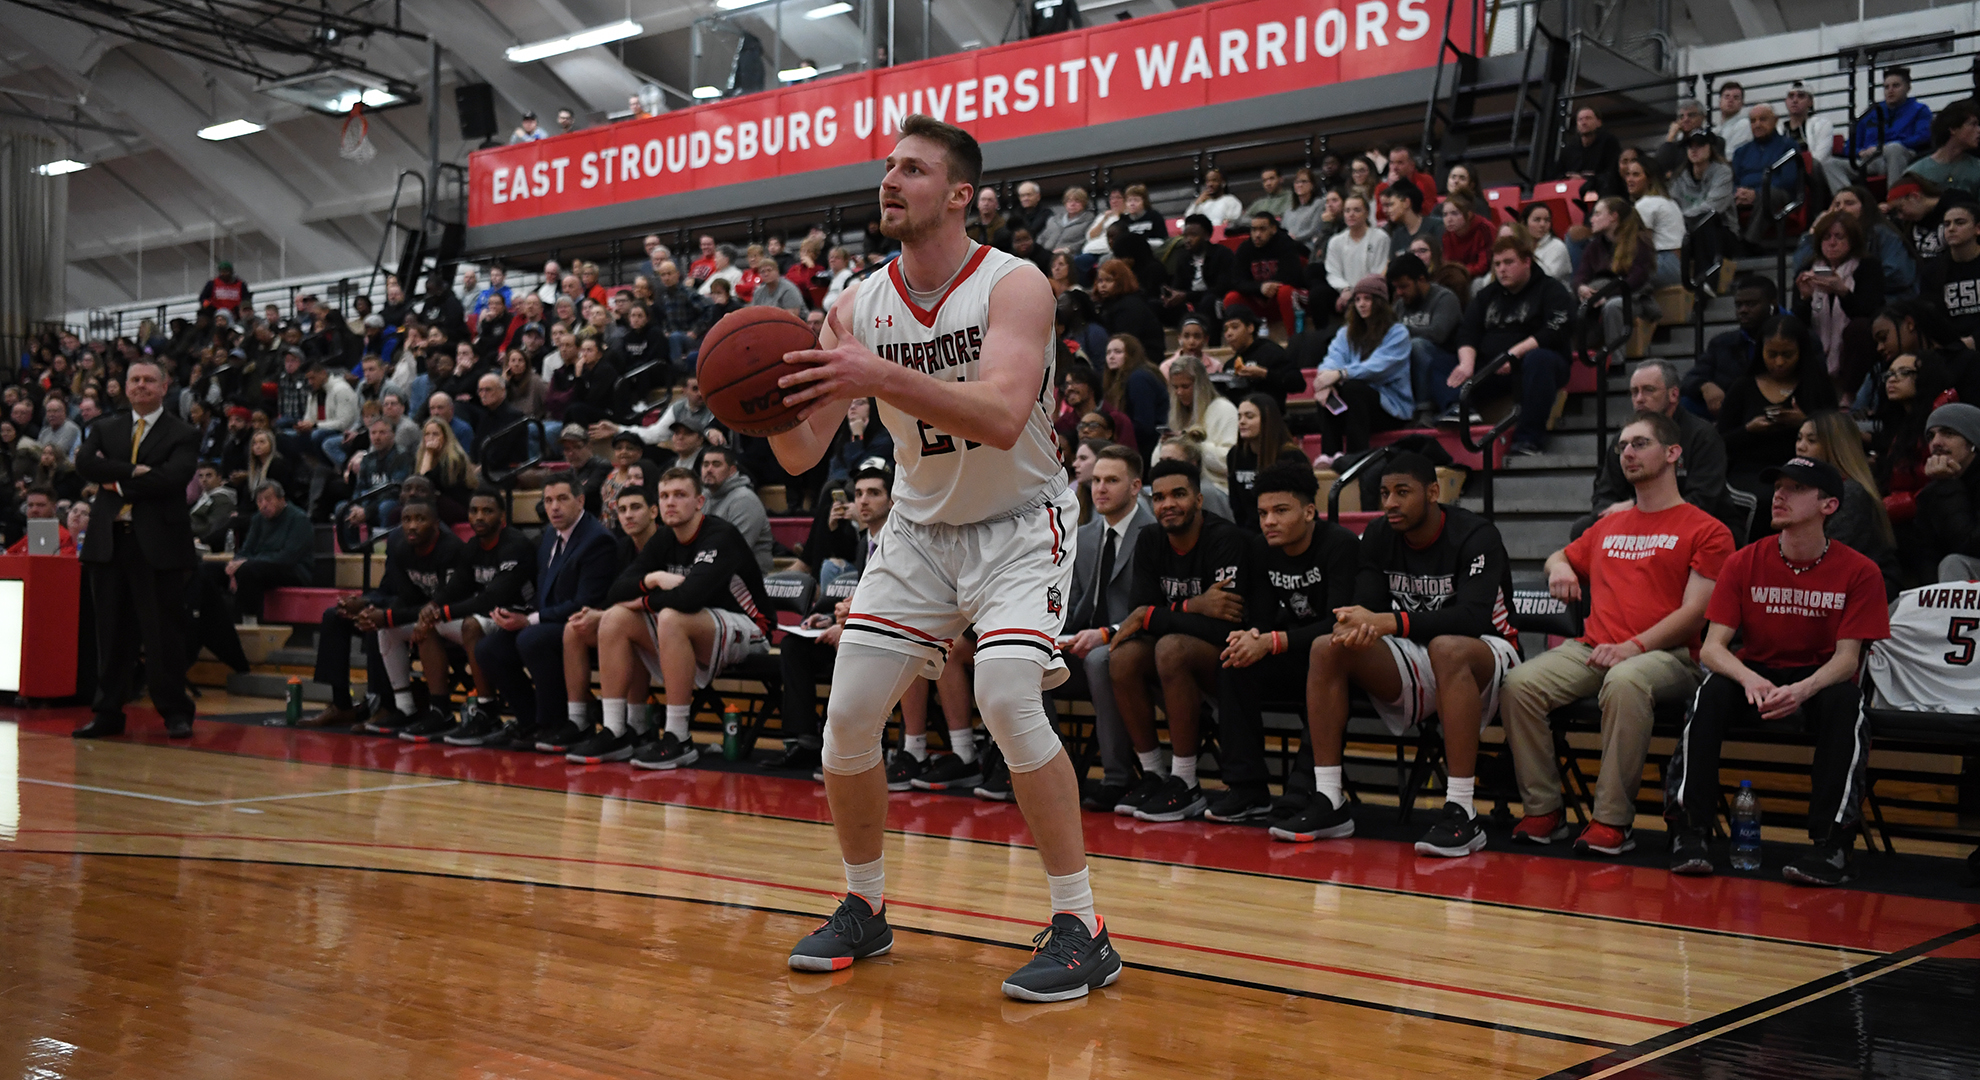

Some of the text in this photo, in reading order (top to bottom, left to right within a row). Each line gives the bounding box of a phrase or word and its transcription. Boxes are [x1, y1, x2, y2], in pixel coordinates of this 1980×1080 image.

[492, 0, 1431, 204] EAST STROUDSBURG UNIVERSITY WARRIORS
[877, 326, 982, 375] WARRIORS
[1602, 533, 1679, 551] WARRIORS
[1607, 549, 1656, 560] BASKETBALL
[764, 585, 805, 598] ARRIORS
[1750, 586, 1847, 610] WARRIORS
[1512, 597, 1567, 615] RRIORS
[1765, 605, 1828, 617] BASKETBALL
[1944, 616, 1980, 666] 5
